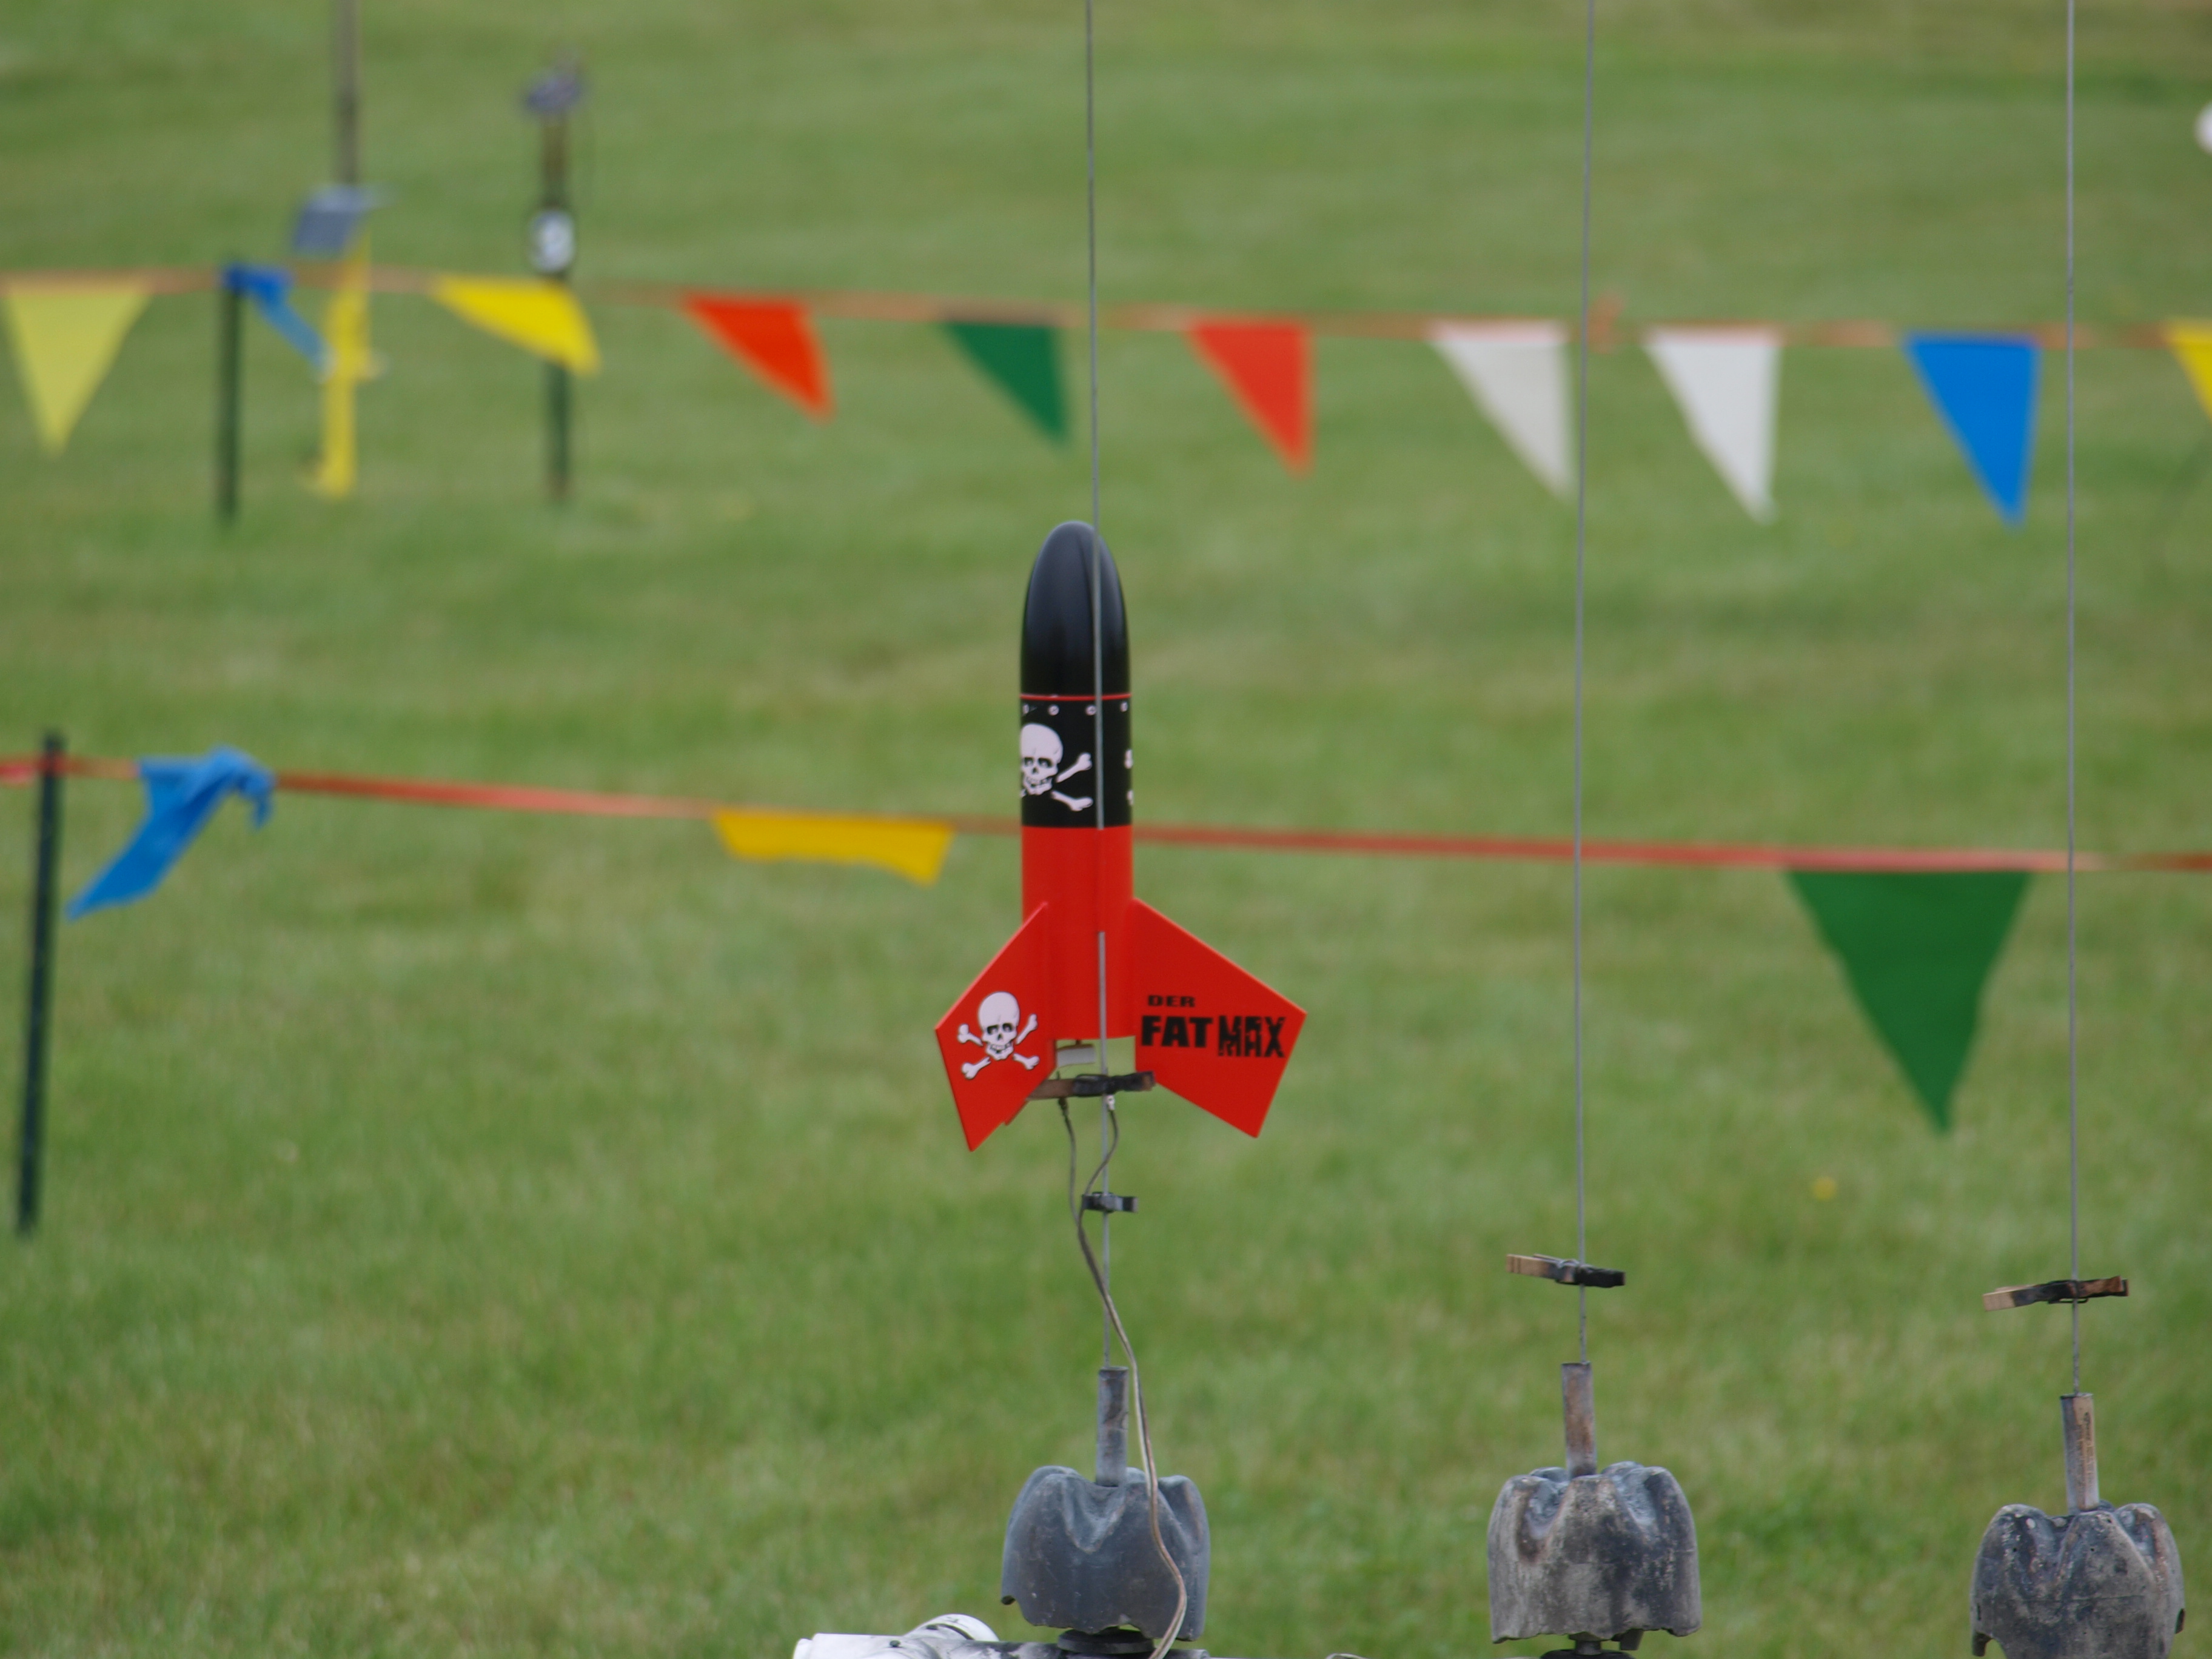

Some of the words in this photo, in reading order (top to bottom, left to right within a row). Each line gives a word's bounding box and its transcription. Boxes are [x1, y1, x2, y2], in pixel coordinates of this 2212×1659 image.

[1147, 995, 1195, 1007] DER
[1141, 1015, 1213, 1048] FAT
[1218, 1015, 1285, 1057] MAX
